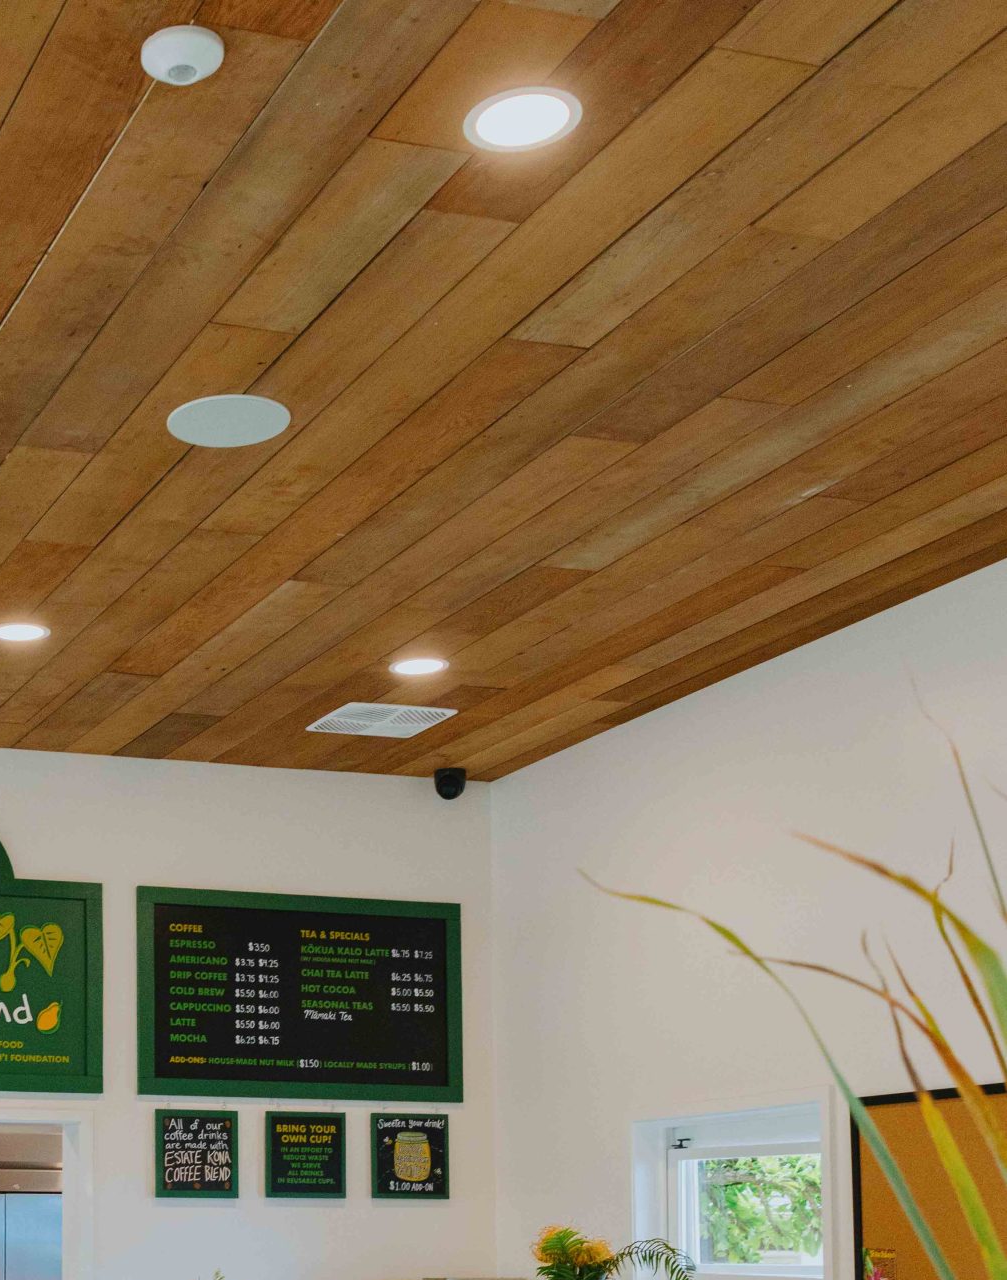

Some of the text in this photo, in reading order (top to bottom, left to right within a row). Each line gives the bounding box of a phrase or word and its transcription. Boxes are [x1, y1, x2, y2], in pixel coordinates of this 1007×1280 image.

[169, 924, 203, 933] COFFEE
[301, 930, 370, 941] TEA & SPECIALS
[170, 940, 215, 949] ESPRESSO
[338, 948, 362, 956] KALO
[365, 948, 390, 957] LATTE
[169, 955, 228, 966] AMERICANO
[235, 958, 255, 967] $3.75
[170, 971, 192, 979] DRIP
[195, 972, 227, 981] COFFEE
[235, 973, 255, 982] $3.75
[301, 968, 323, 977] CHAI
[326, 969, 342, 978] TEA
[345, 970, 369, 979] LATTE
[170, 987, 279, 999] COLD BREW $5.50 $6.00
[301, 984, 320, 993] HOT
[323, 985, 356, 994] COCOA
[169, 1002, 279, 1014] CAPPUCCINO $5.50 $6.00
[301, 1000, 350, 1009] SEASONAL
[353, 1001, 373, 1010] TEAS
[339, 1011, 352, 1021] Tea
[170, 1018, 196, 1027] LATTE
[258, 1020, 280, 1030] $6.00
[170, 1034, 207, 1042] MOCHA
[258, 1035, 280, 1045] $6.75
[11, 1054, 69, 1063] FOUNDATION
[169, 1056, 206, 1064] ADD-ONS:
[208, 1057, 257, 1065] HOUSE-MADE
[259, 1058, 274, 1066] NUT
[276, 1059, 294, 1067] MILK
[169, 1118, 183, 1130] All
[190, 1119, 199, 1130] of
[276, 1124, 337, 1133] BRING YOUR
[409, 1120, 424, 1128] your
[424, 1118, 445, 1129] drink!
[164, 1129, 228, 1140] coffee drinks
[281, 1135, 332, 1143] OWN CUP!
[185, 1140, 207, 1149] made
[210, 1140, 229, 1150] with
[165, 1150, 232, 1167] ESTATE KONA
[165, 1165, 231, 1182] COFFEE BLEND
[389, 1181, 433, 1191] $1.00 ADD-ON
